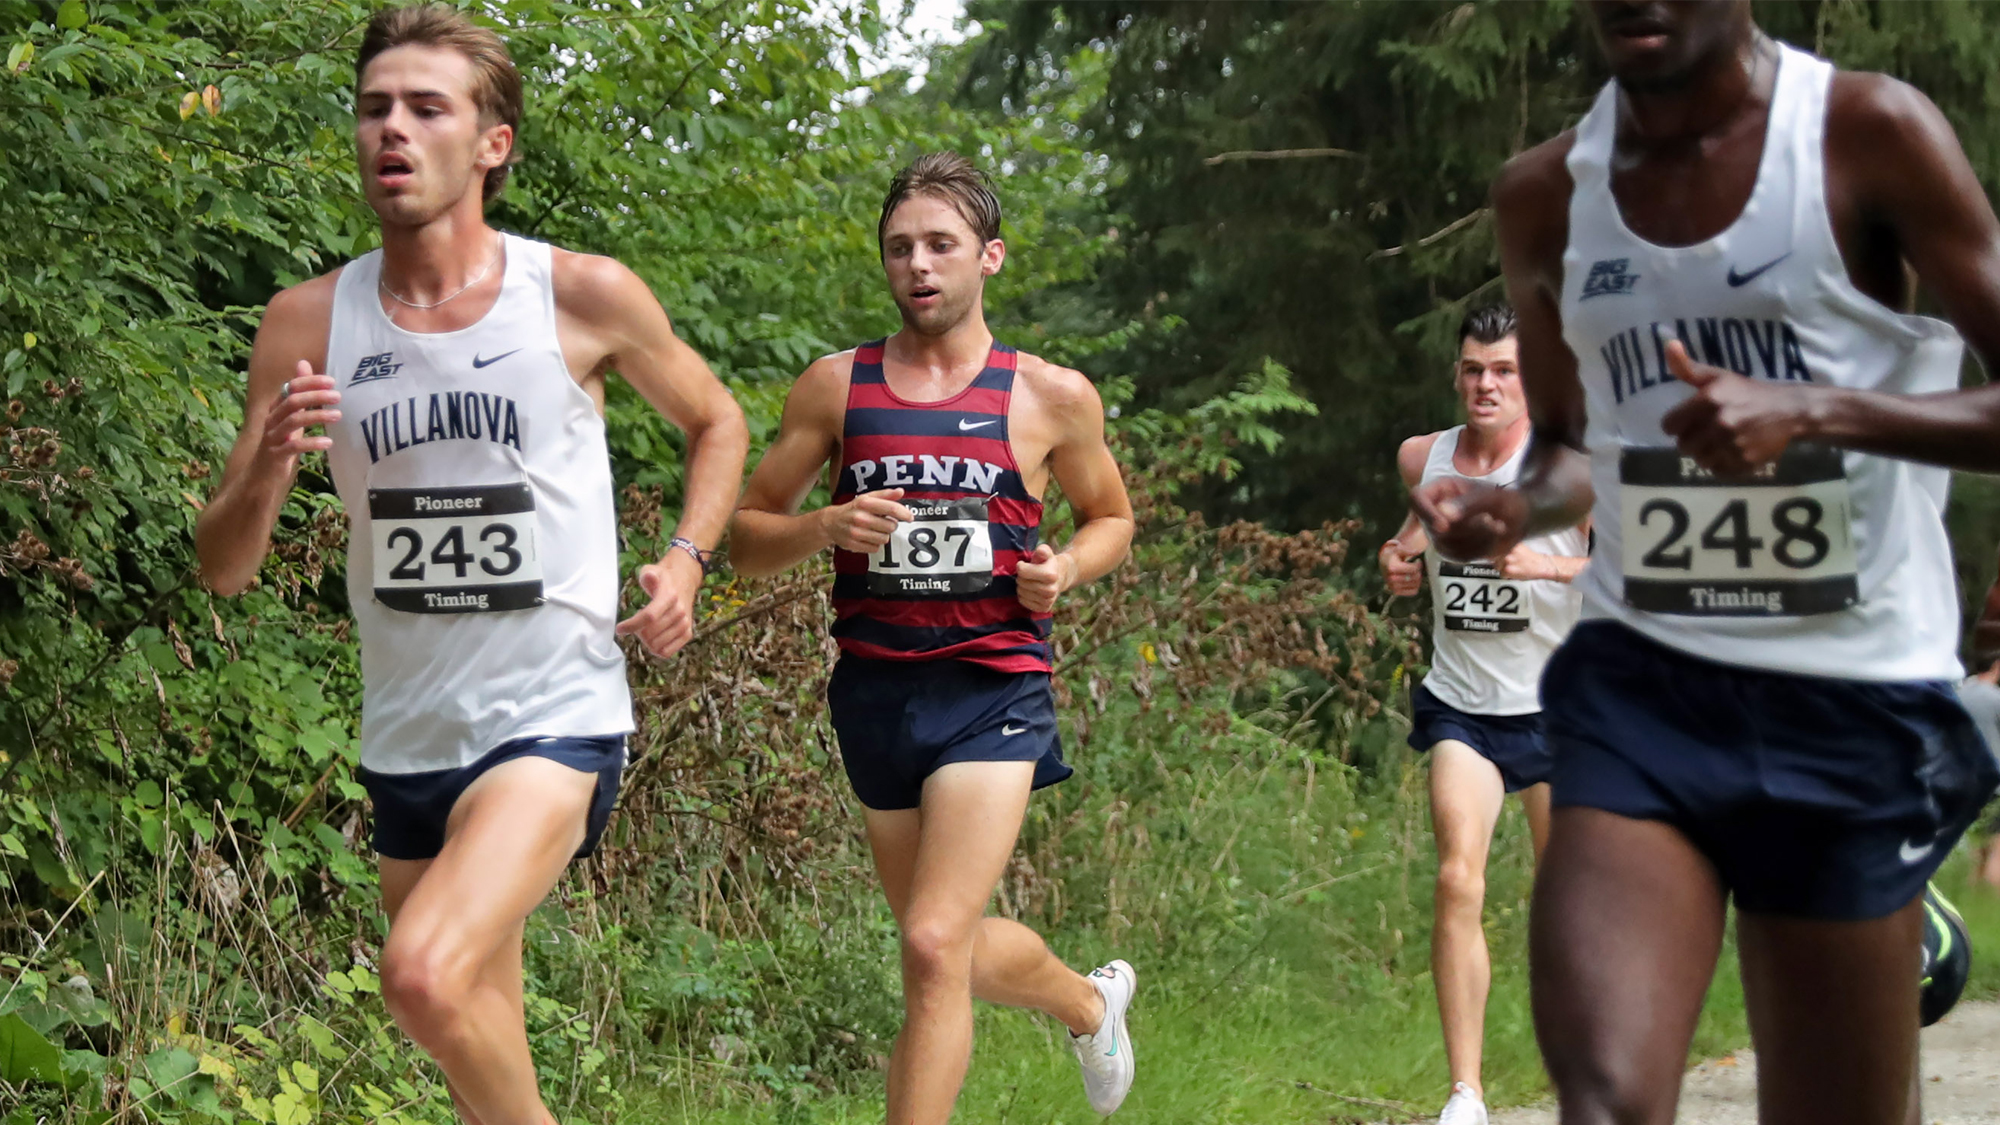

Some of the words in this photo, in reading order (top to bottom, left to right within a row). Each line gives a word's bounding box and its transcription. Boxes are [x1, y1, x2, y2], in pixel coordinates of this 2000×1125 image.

[1590, 258, 1630, 275] BIG
[1582, 274, 1641, 292] EAST
[358, 352, 394, 369] BIG
[351, 363, 403, 381] EAST
[360, 390, 522, 465] VILLANOVA
[850, 454, 1003, 494] PENN
[414, 496, 483, 511] Pioneer
[905, 504, 949, 516] oneer
[1638, 496, 1830, 570] 248
[387, 522, 522, 581] 243
[879, 526, 975, 568] 187
[900, 577, 951, 591] Timing
[424, 592, 489, 609] Timing
[1446, 582, 1519, 614] 242
[1688, 587, 1782, 612] Timing
[1462, 618, 1499, 632] Timing
